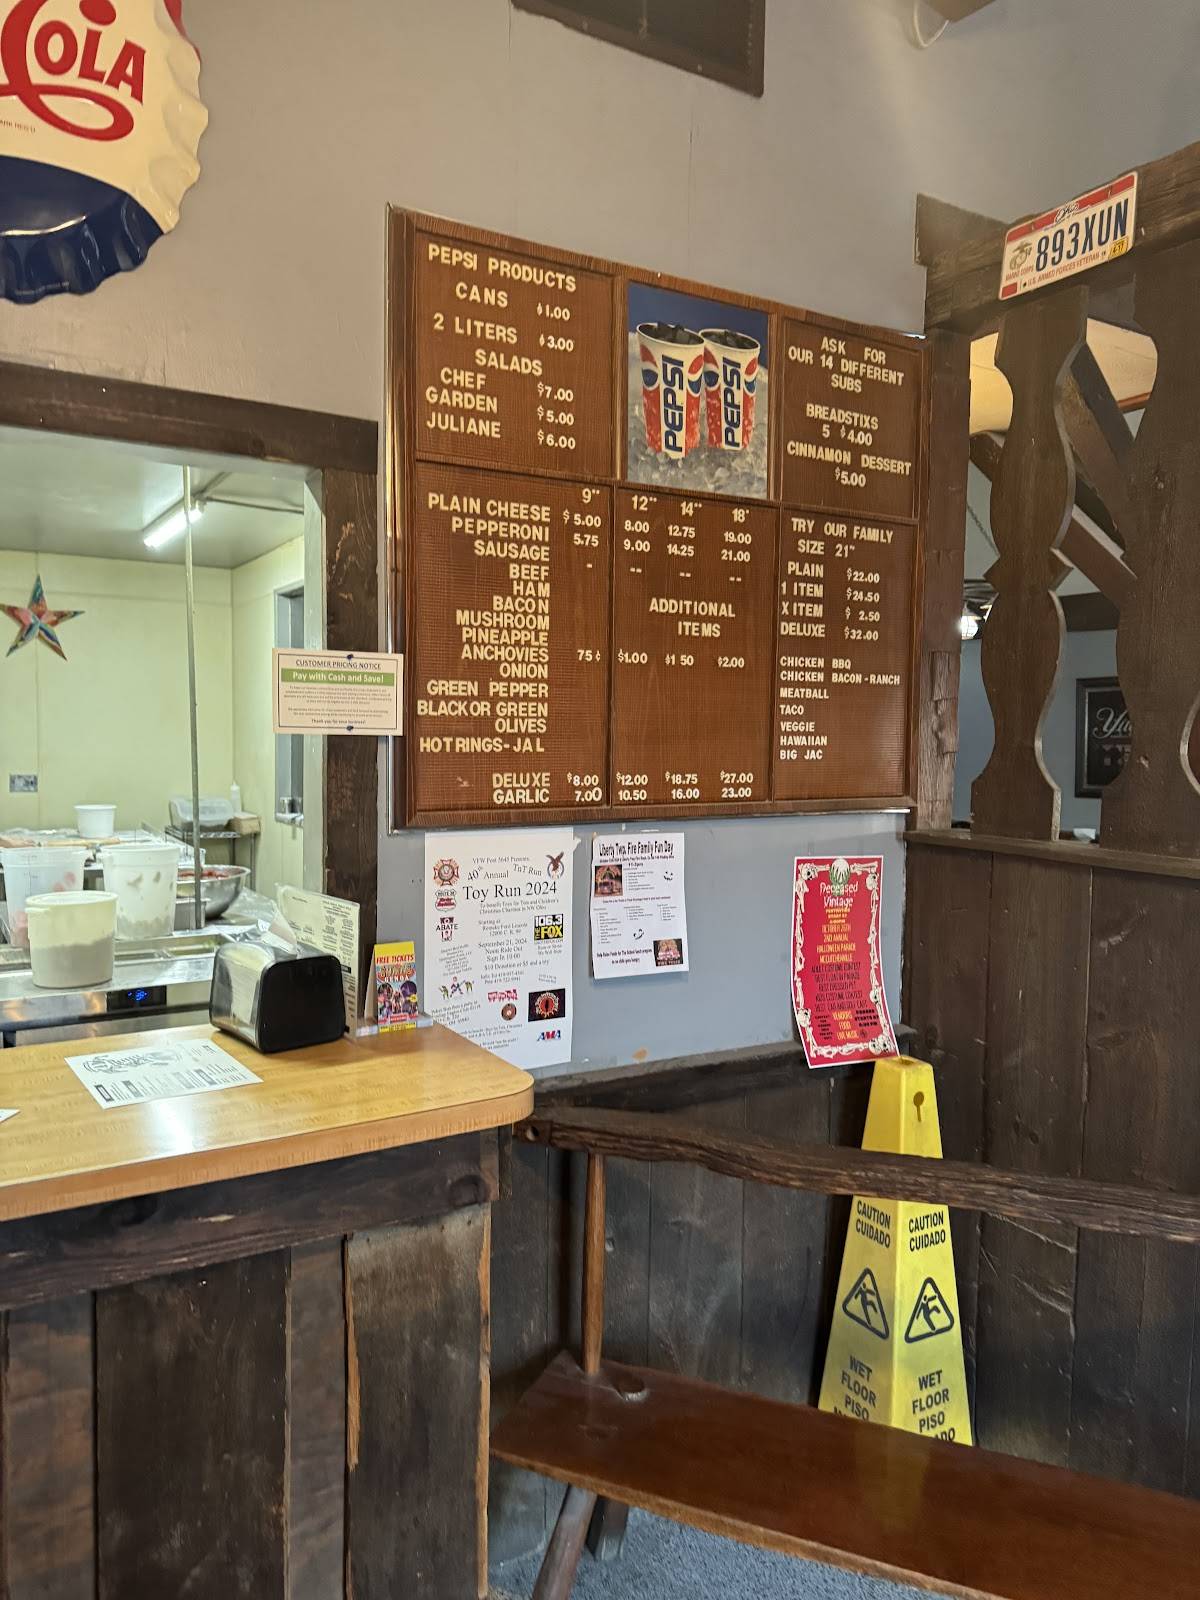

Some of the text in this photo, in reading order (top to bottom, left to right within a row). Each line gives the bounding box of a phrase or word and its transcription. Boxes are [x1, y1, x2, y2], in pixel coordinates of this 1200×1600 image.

[1036, 198, 1128, 272] 893XUN
[429, 243, 576, 293] PEPSI PRODUCTS
[455, 282, 570, 321] CANS $1.00
[433, 312, 575, 352] 2 LITERS $3.00
[821, 336, 886, 365] ASK FOR
[475, 349, 543, 377] SALADS
[788, 346, 904, 386] OUR 14 DIFFERENT
[440, 367, 574, 402] CHEF $7.00
[831, 374, 862, 393] SUBS
[425, 386, 575, 426] GARDEN $5.00
[662, 354, 684, 453] PEPSI
[722, 356, 742, 448] PEPSI
[806, 403, 879, 430] BREADSTIXS
[426, 411, 576, 450] JULIANE $6.00
[822, 424, 873, 446] 5 $4.00
[787, 441, 912, 475] CINNAMON DESSERT
[835, 467, 866, 487] $5.00
[428, 492, 752, 545] PLAIN CHEESE $5.00 8.00 12.75 19.00
[451, 516, 750, 562] PEPPERONI 5.75 9.00 14.25 21.00
[791, 517, 893, 544] TRY OUR FAMILY
[474, 540, 550, 561] SAUSAGE
[797, 539, 825, 555] SIZE
[509, 563, 550, 581] BEEF
[788, 561, 880, 583] PLAIN $22.00
[512, 580, 550, 598] HAM
[781, 581, 880, 602] 1 ITEM $24.50
[492, 595, 549, 614] BACON
[649, 597, 736, 618] ADDITIONAL
[781, 601, 790, 615] X
[793, 602, 823, 618] ITEM
[456, 609, 550, 630] MUSHROOM
[678, 621, 721, 638] ITEMS
[462, 627, 549, 646] PINEAPPLE
[780, 622, 879, 641] DELUXE $32.00
[296, 659, 381, 670] CUSTOMER PRICING NOTICE
[461, 644, 549, 663] ANCHOVIES
[618, 648, 648, 664] $1.00
[717, 656, 745, 668] $2.00
[780, 656, 851, 670] CHICKEN BBQ
[293, 672, 307, 680] Pay
[308, 672, 327, 680] with
[328, 673, 346, 681] Cash
[363, 674, 384, 683] Save!
[500, 663, 549, 679] ONION
[780, 671, 824, 682] CHICKEN
[426, 680, 549, 698] GREEN PEPPER
[780, 687, 829, 699] MEATBALL
[496, 702, 548, 717] GREEN
[780, 704, 804, 716] TACO
[495, 718, 547, 734] OLIVES
[780, 721, 815, 732] VEGGIE
[780, 735, 828, 746] HAWAIIAN
[780, 749, 823, 760] BIG JAC
[492, 771, 753, 789] DELUXE $8.00 $12.00 $18.75 $27.00
[492, 787, 752, 805] GARLIC 7.00 10.50 16.00 23.00
[599, 844, 614, 858] Liberty
[628, 842, 636, 854] Fire
[638, 841, 653, 857] Family
[655, 841, 663, 853] Fun
[665, 840, 673, 855] Day
[483, 871, 509, 879] Annual
[528, 866, 542, 876] Run
[462, 886, 489, 902] Toy
[494, 884, 521, 898] Run
[526, 881, 557, 896] 2024
[824, 895, 853, 910] Vintage
[536, 915, 562, 927] 106.3
[541, 925, 563, 939] FOX
[537, 1030, 561, 1041] AMA
[856, 1200, 891, 1229] CAUTION
[909, 1210, 944, 1233] CAUTION
[855, 1219, 891, 1249] CUIDADO
[909, 1229, 946, 1252] CUIDADO
[849, 1354, 873, 1382] WET
[841, 1370, 877, 1408] FLOOR
[918, 1369, 943, 1392] WET
[844, 1394, 870, 1422] PISO
[912, 1387, 950, 1415] FLOOR
[919, 1411, 945, 1433] PISO
